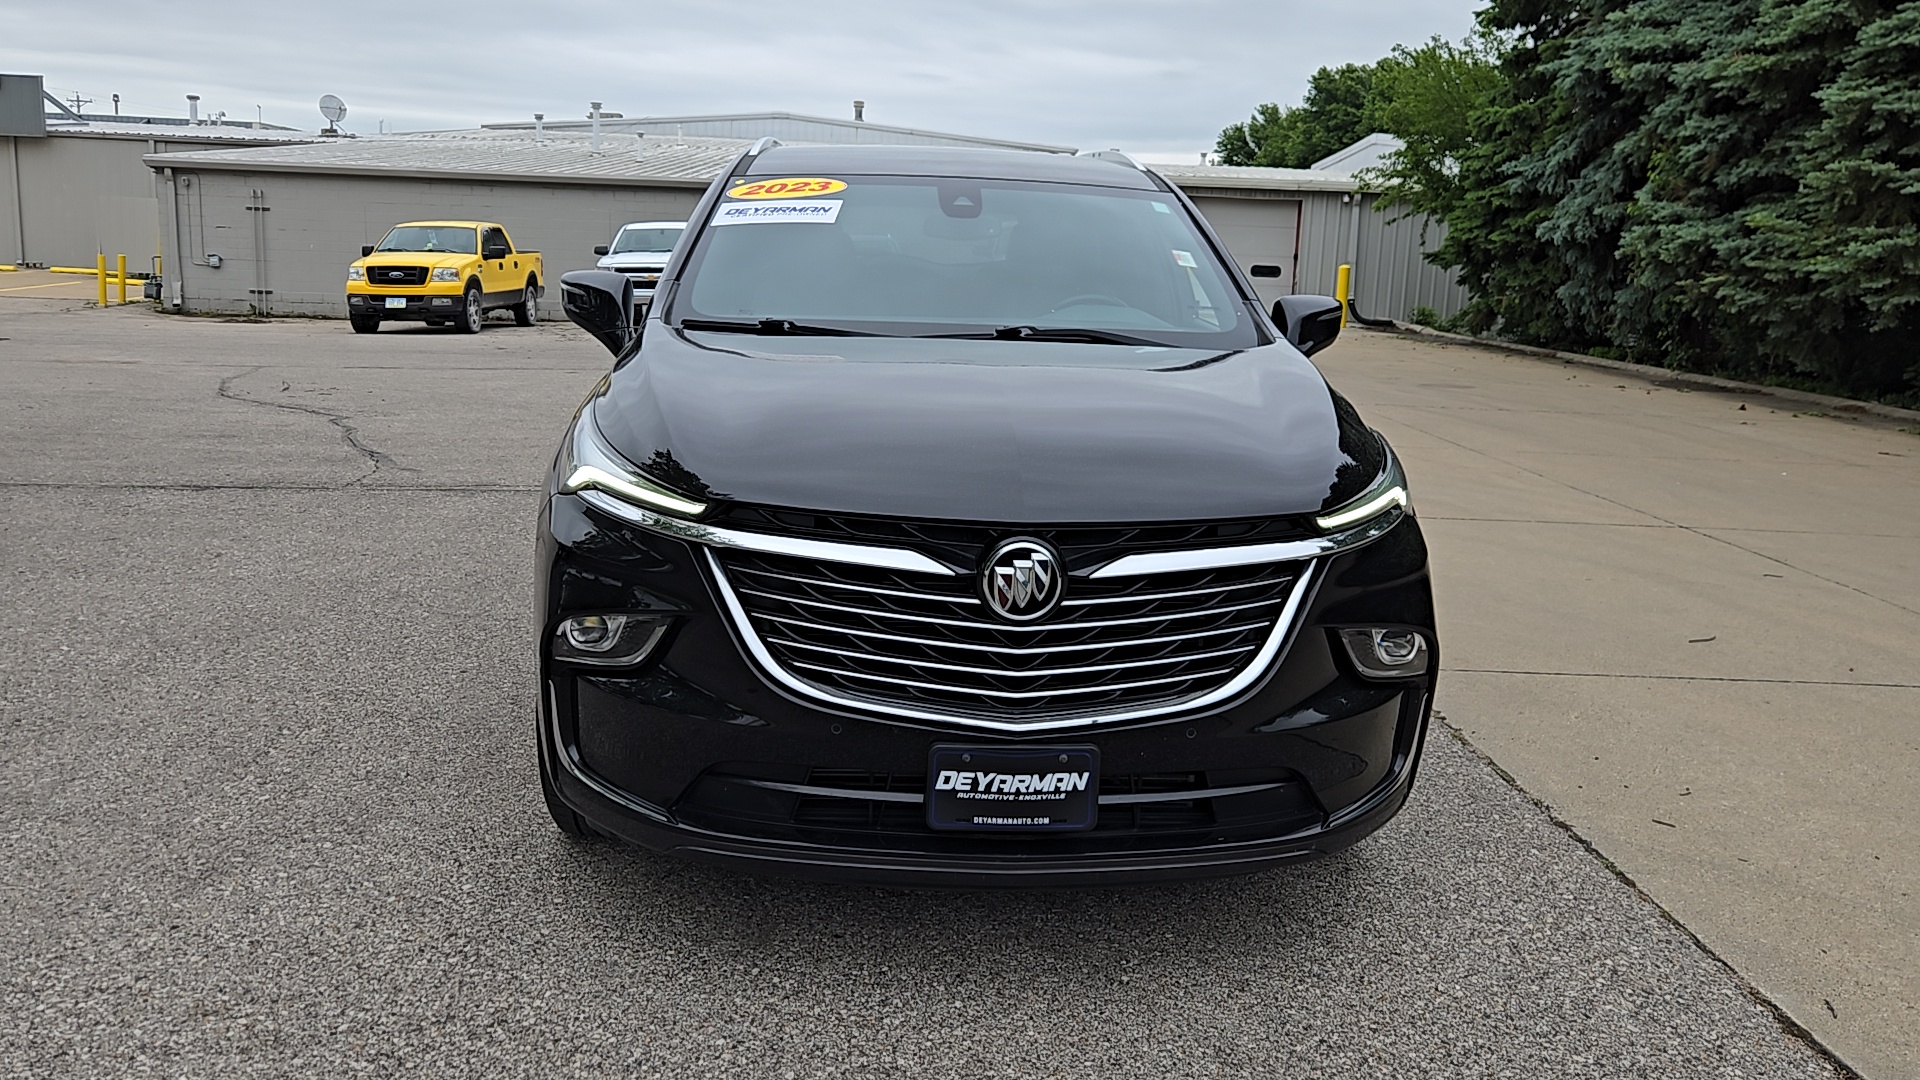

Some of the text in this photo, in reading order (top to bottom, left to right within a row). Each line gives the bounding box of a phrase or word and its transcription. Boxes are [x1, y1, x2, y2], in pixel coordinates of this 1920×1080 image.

[739, 181, 832, 196] 2023
[724, 206, 833, 216] DEYARMAN
[935, 770, 1090, 793] DEYARMAN
[973, 816, 1050, 825] DEYARMANAUTO.COM
